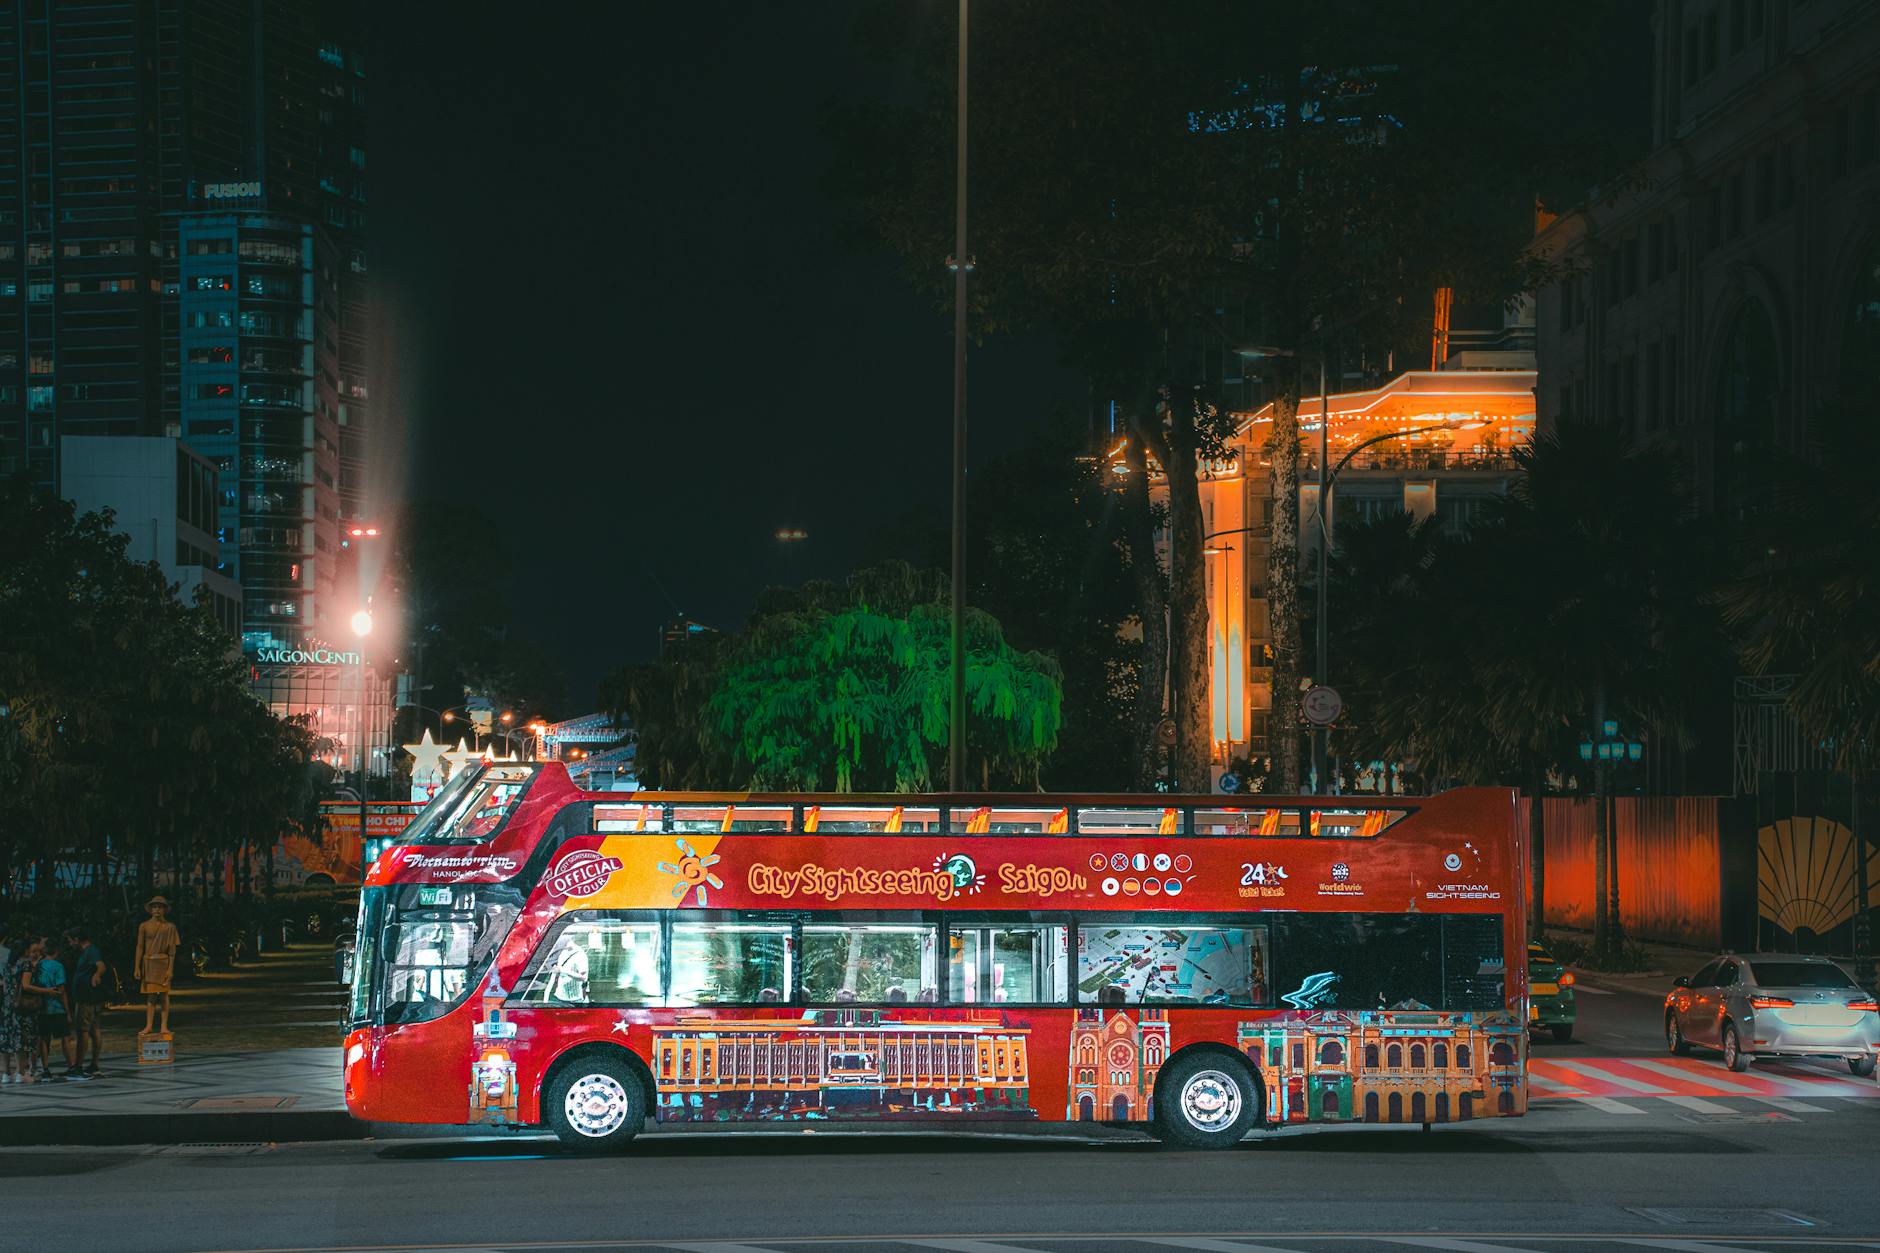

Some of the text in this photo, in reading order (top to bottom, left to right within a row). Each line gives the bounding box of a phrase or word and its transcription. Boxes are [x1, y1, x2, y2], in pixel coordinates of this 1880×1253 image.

[204, 182, 261, 199] FUSION
[366, 816, 383, 826] HO
[385, 816, 405, 826] CHI
[567, 852, 601, 864] SIGHTSEEING
[554, 859, 620, 892] OFFICIAL
[998, 862, 1087, 897] Saigon
[1240, 863, 1265, 886] 24
[577, 876, 606, 895] TOUR
